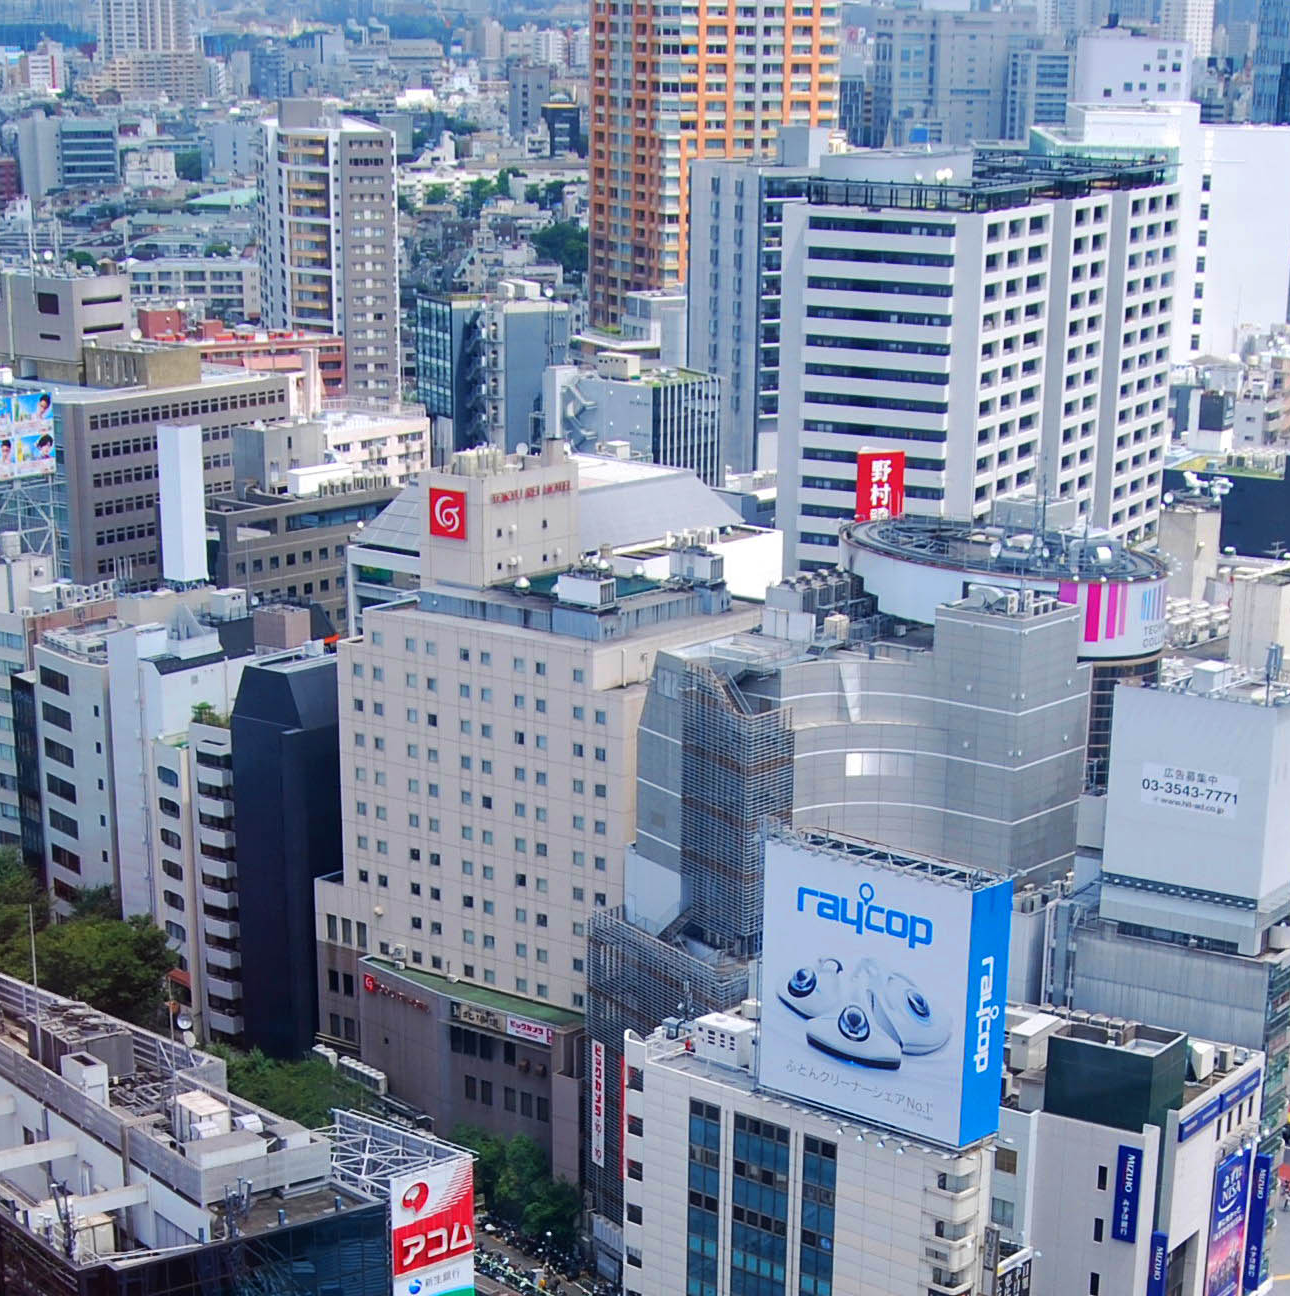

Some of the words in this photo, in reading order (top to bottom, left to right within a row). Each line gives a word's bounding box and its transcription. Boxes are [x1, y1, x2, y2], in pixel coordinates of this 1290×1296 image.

[1142, 778, 1238, 805] 03-3543-7771
[797, 882, 934, 950] raycop
[973, 955, 1000, 1074] raycop
[1124, 1153, 1137, 1194] MIZUHO
[1221, 1179, 1243, 1207] NISA
[1257, 1167, 1268, 1201] MIZUHO
[402, 1221, 474, 1268] アコム
[1153, 1245, 1165, 1282] MIZUHO
